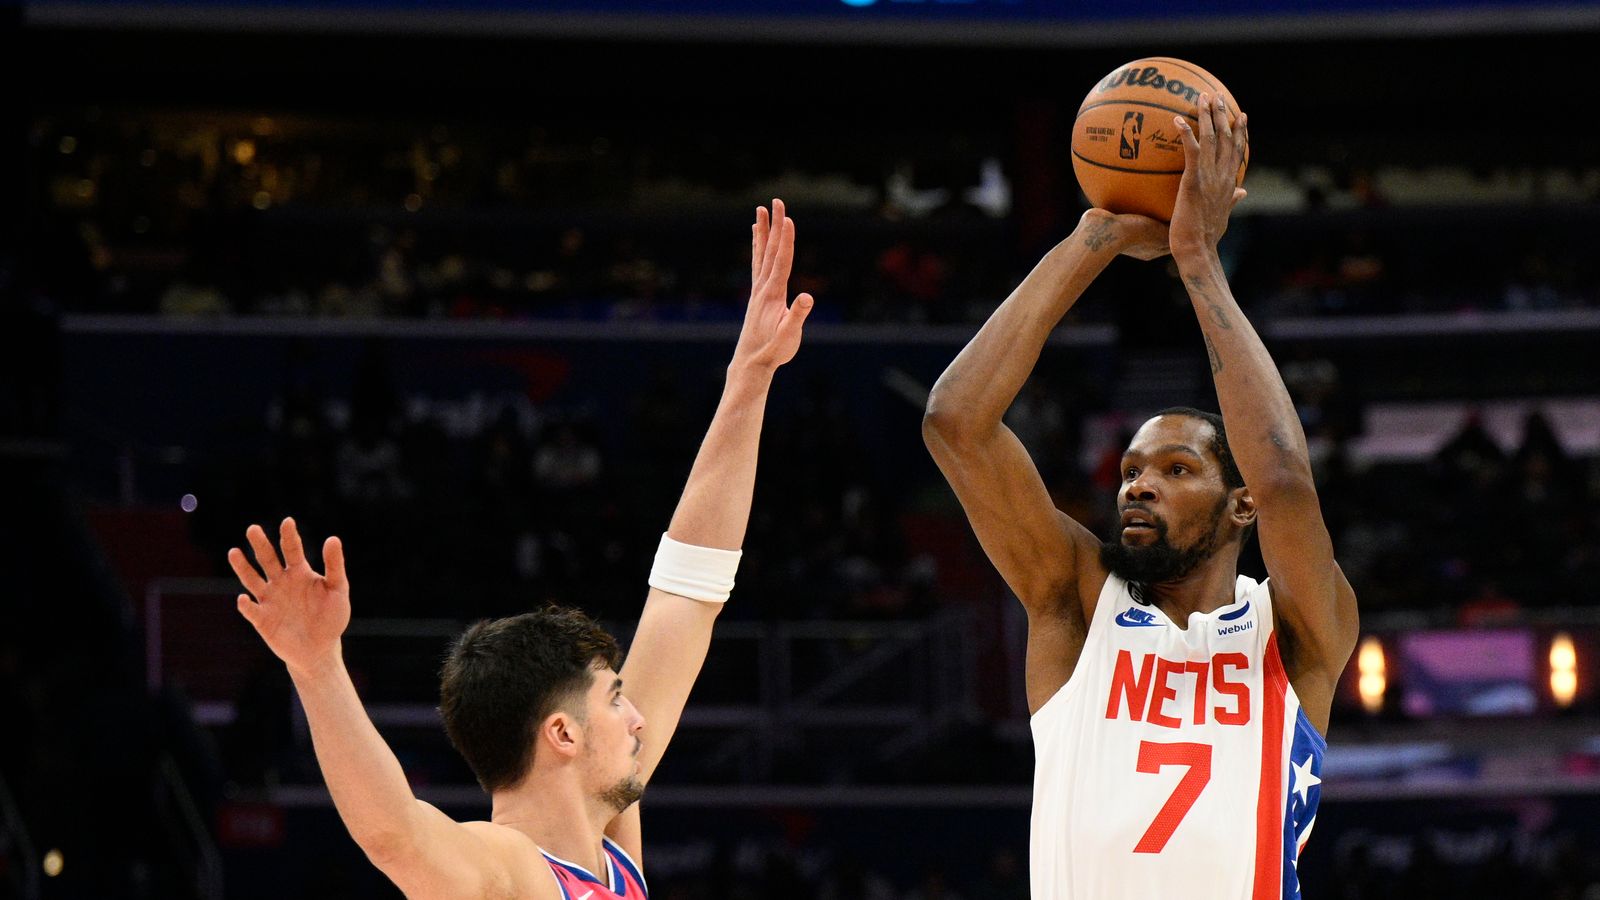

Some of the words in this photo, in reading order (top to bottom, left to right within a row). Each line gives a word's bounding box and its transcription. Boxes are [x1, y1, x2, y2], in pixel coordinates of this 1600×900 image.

[1098, 66, 1200, 105] Wilson
[1124, 607, 1156, 624] NIKE
[1217, 621, 1253, 636] Webull
[1105, 649, 1251, 729] NETS
[1133, 740, 1213, 854] 7
